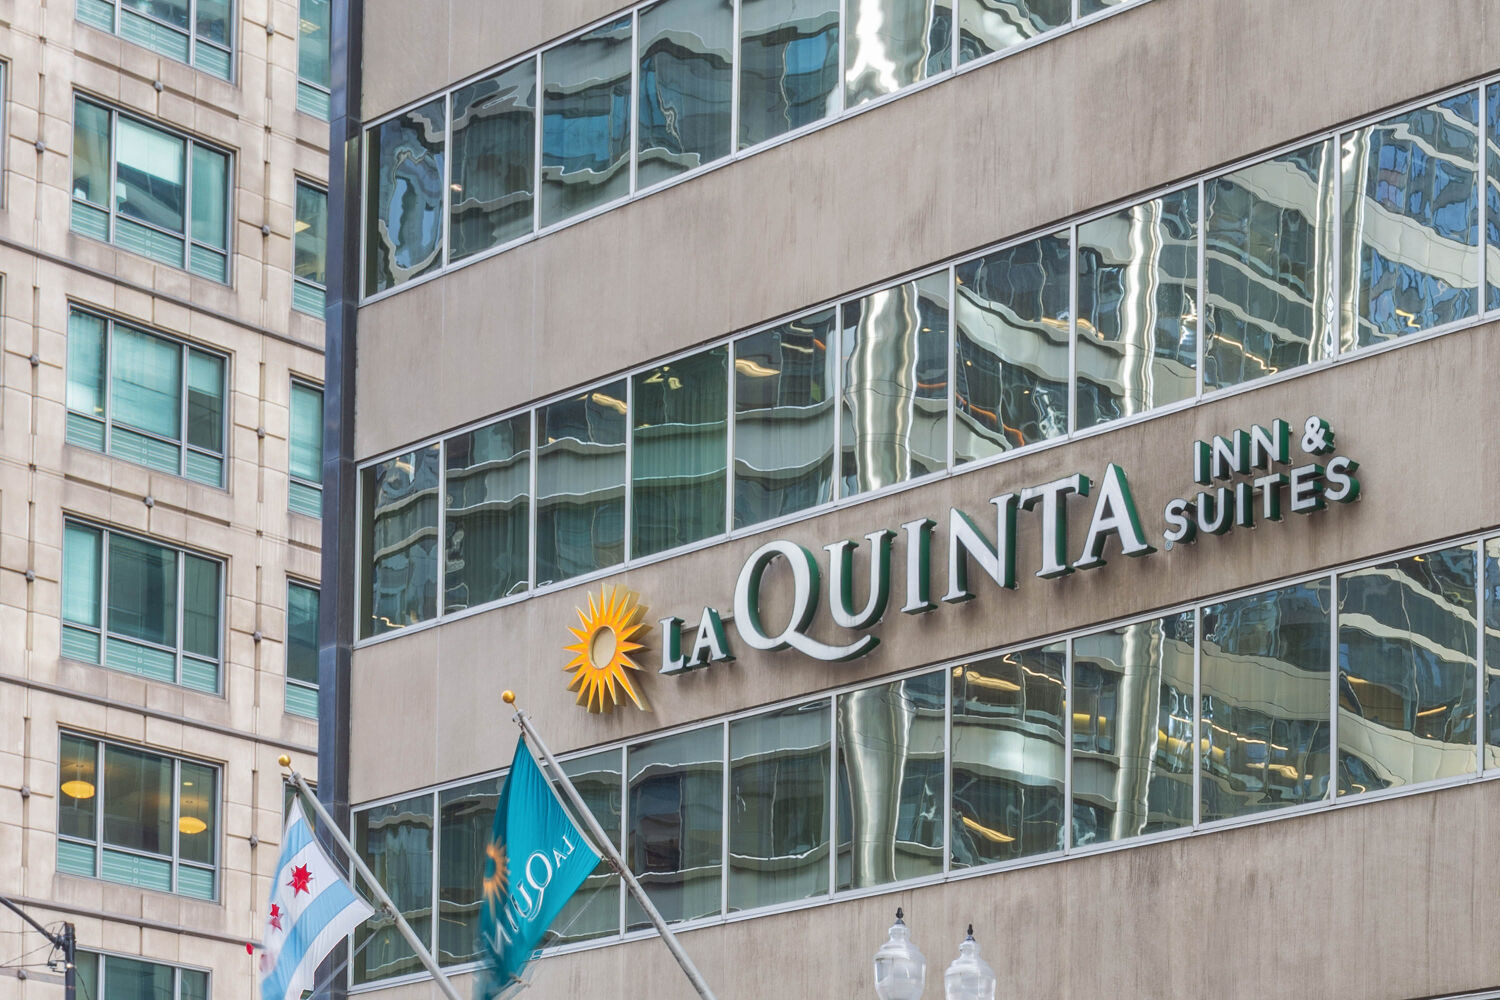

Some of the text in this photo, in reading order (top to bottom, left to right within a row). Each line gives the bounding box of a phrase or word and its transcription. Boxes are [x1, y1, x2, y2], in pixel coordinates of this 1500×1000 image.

[1193, 415, 1336, 487] INN &
[1163, 456, 1361, 545] SUITES
[658, 462, 1158, 676] LA QUINTA
